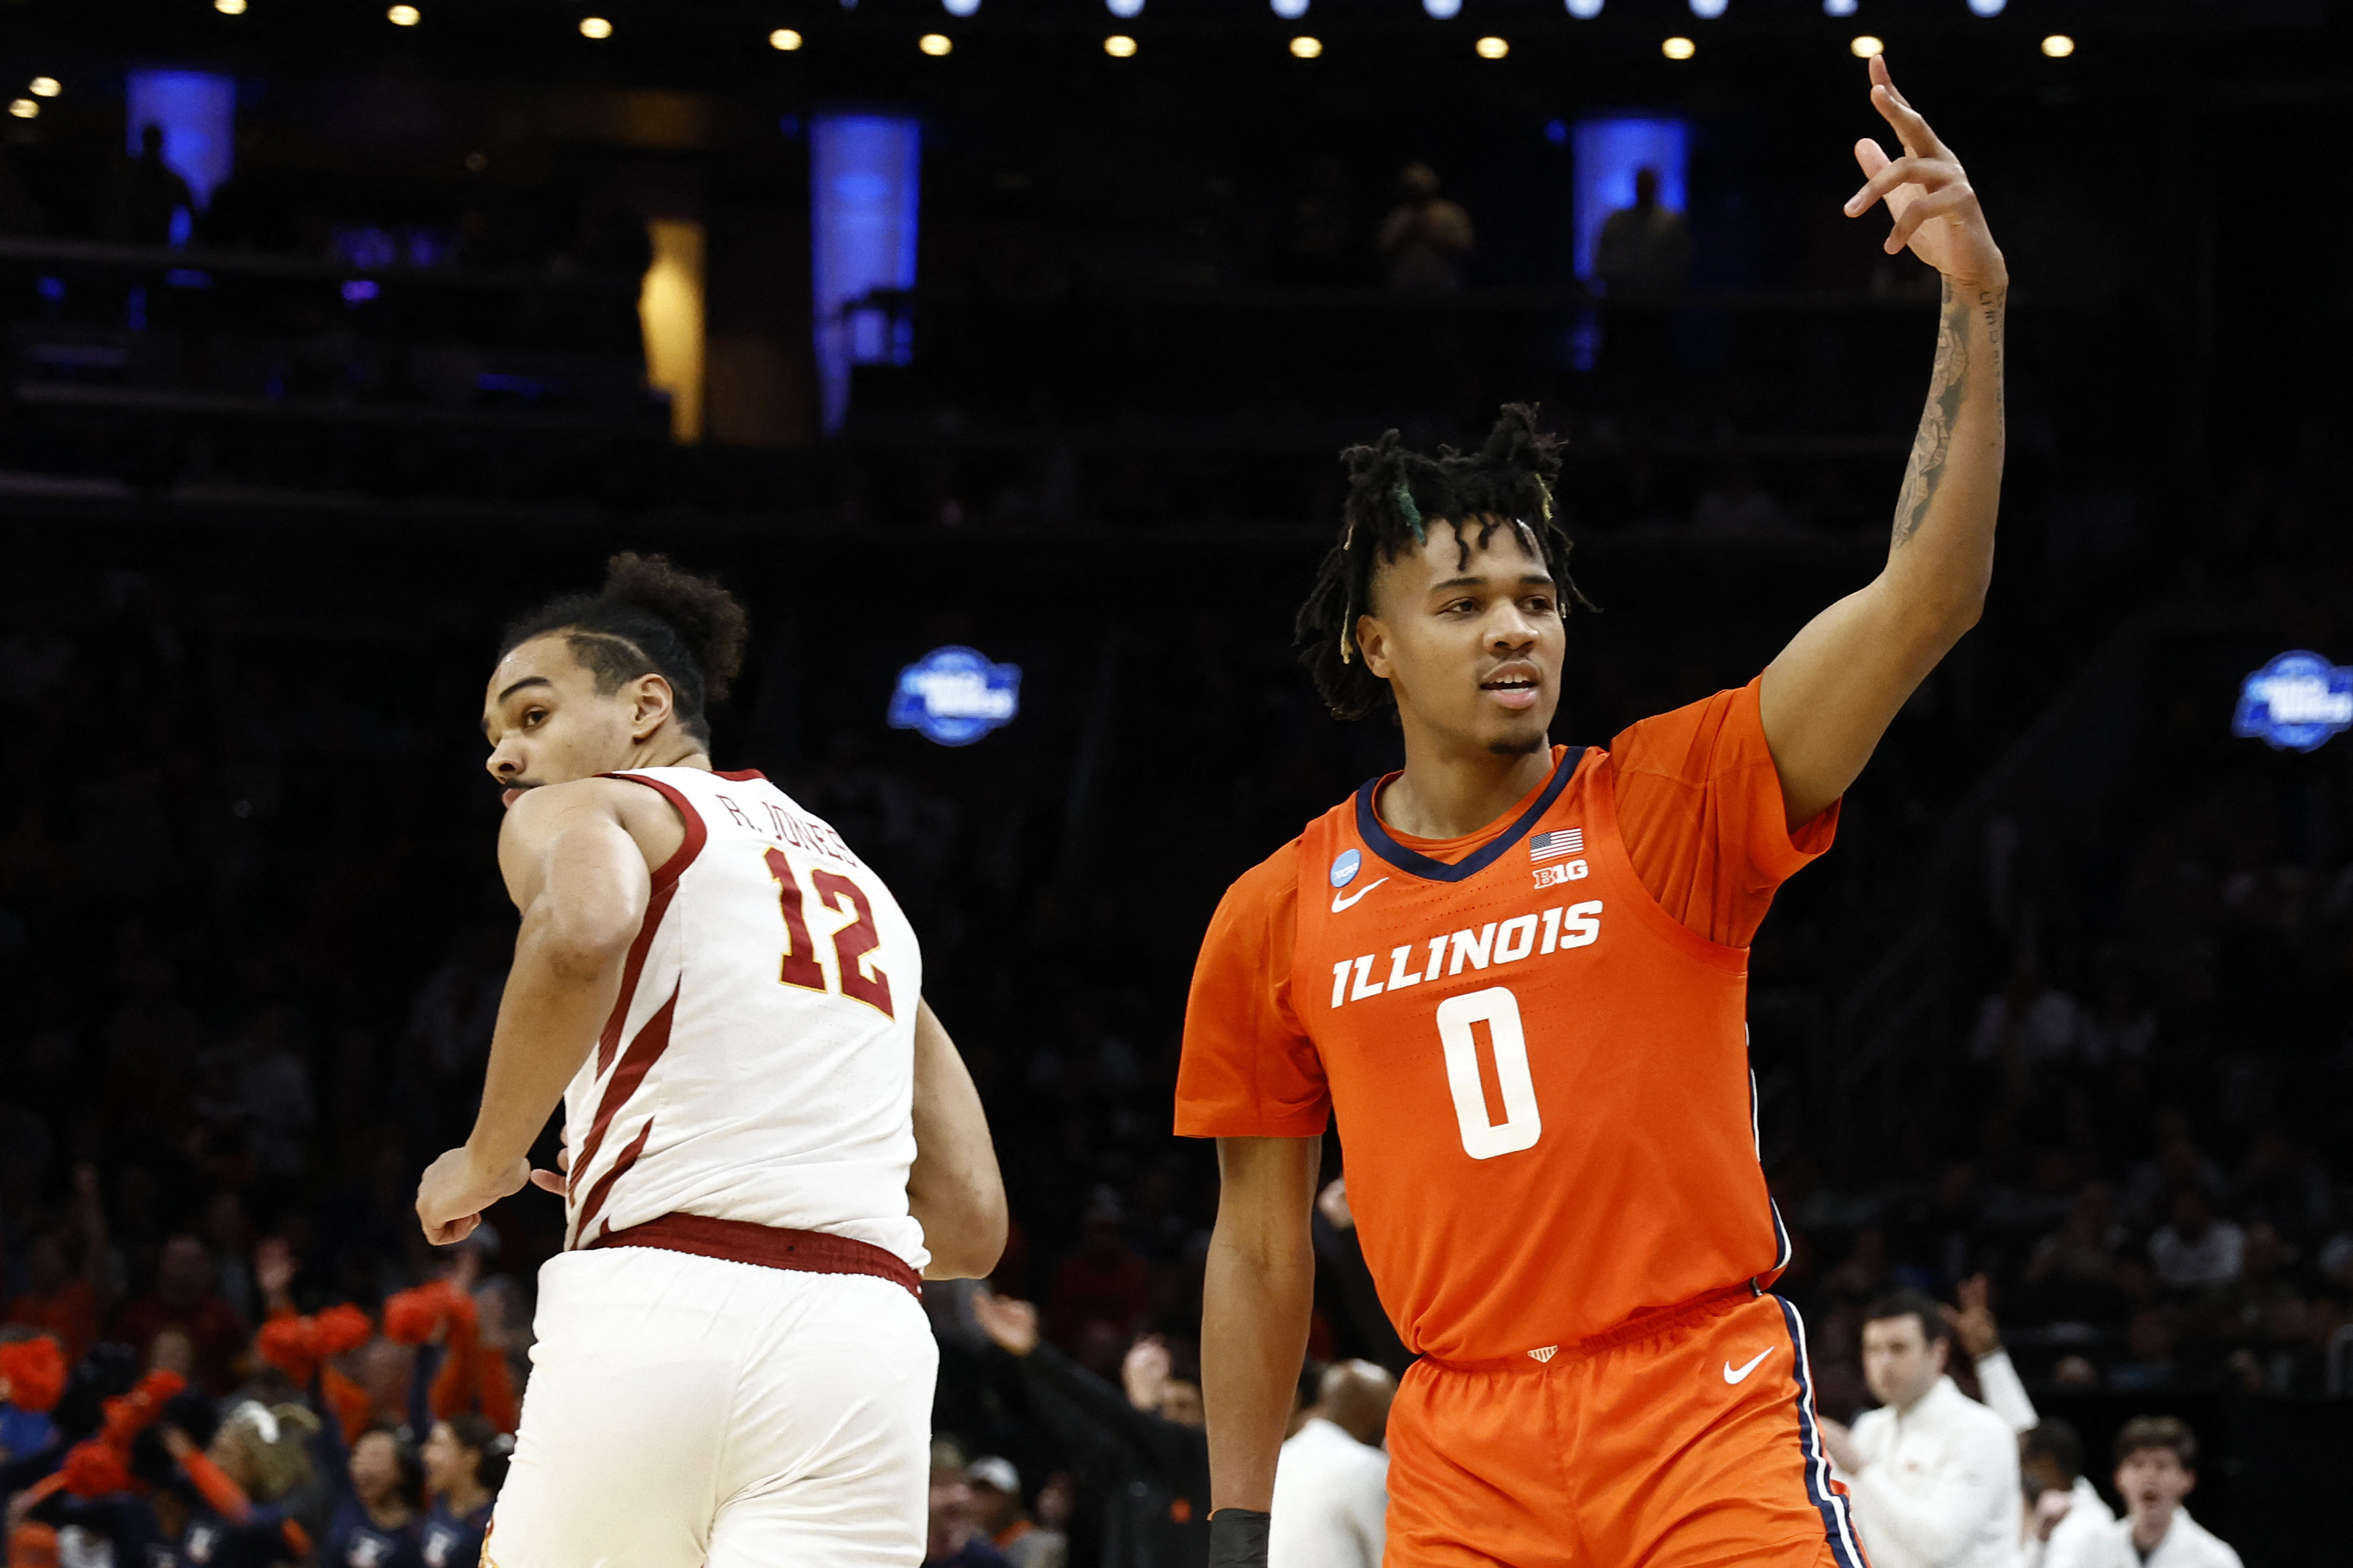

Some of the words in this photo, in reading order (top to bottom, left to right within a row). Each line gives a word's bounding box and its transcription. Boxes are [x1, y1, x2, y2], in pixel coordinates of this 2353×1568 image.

[715, 795, 763, 833] R.
[763, 845, 896, 1024] 12
[1331, 900, 1603, 1009] ILLINOIS
[1436, 986, 1542, 1161] 0
